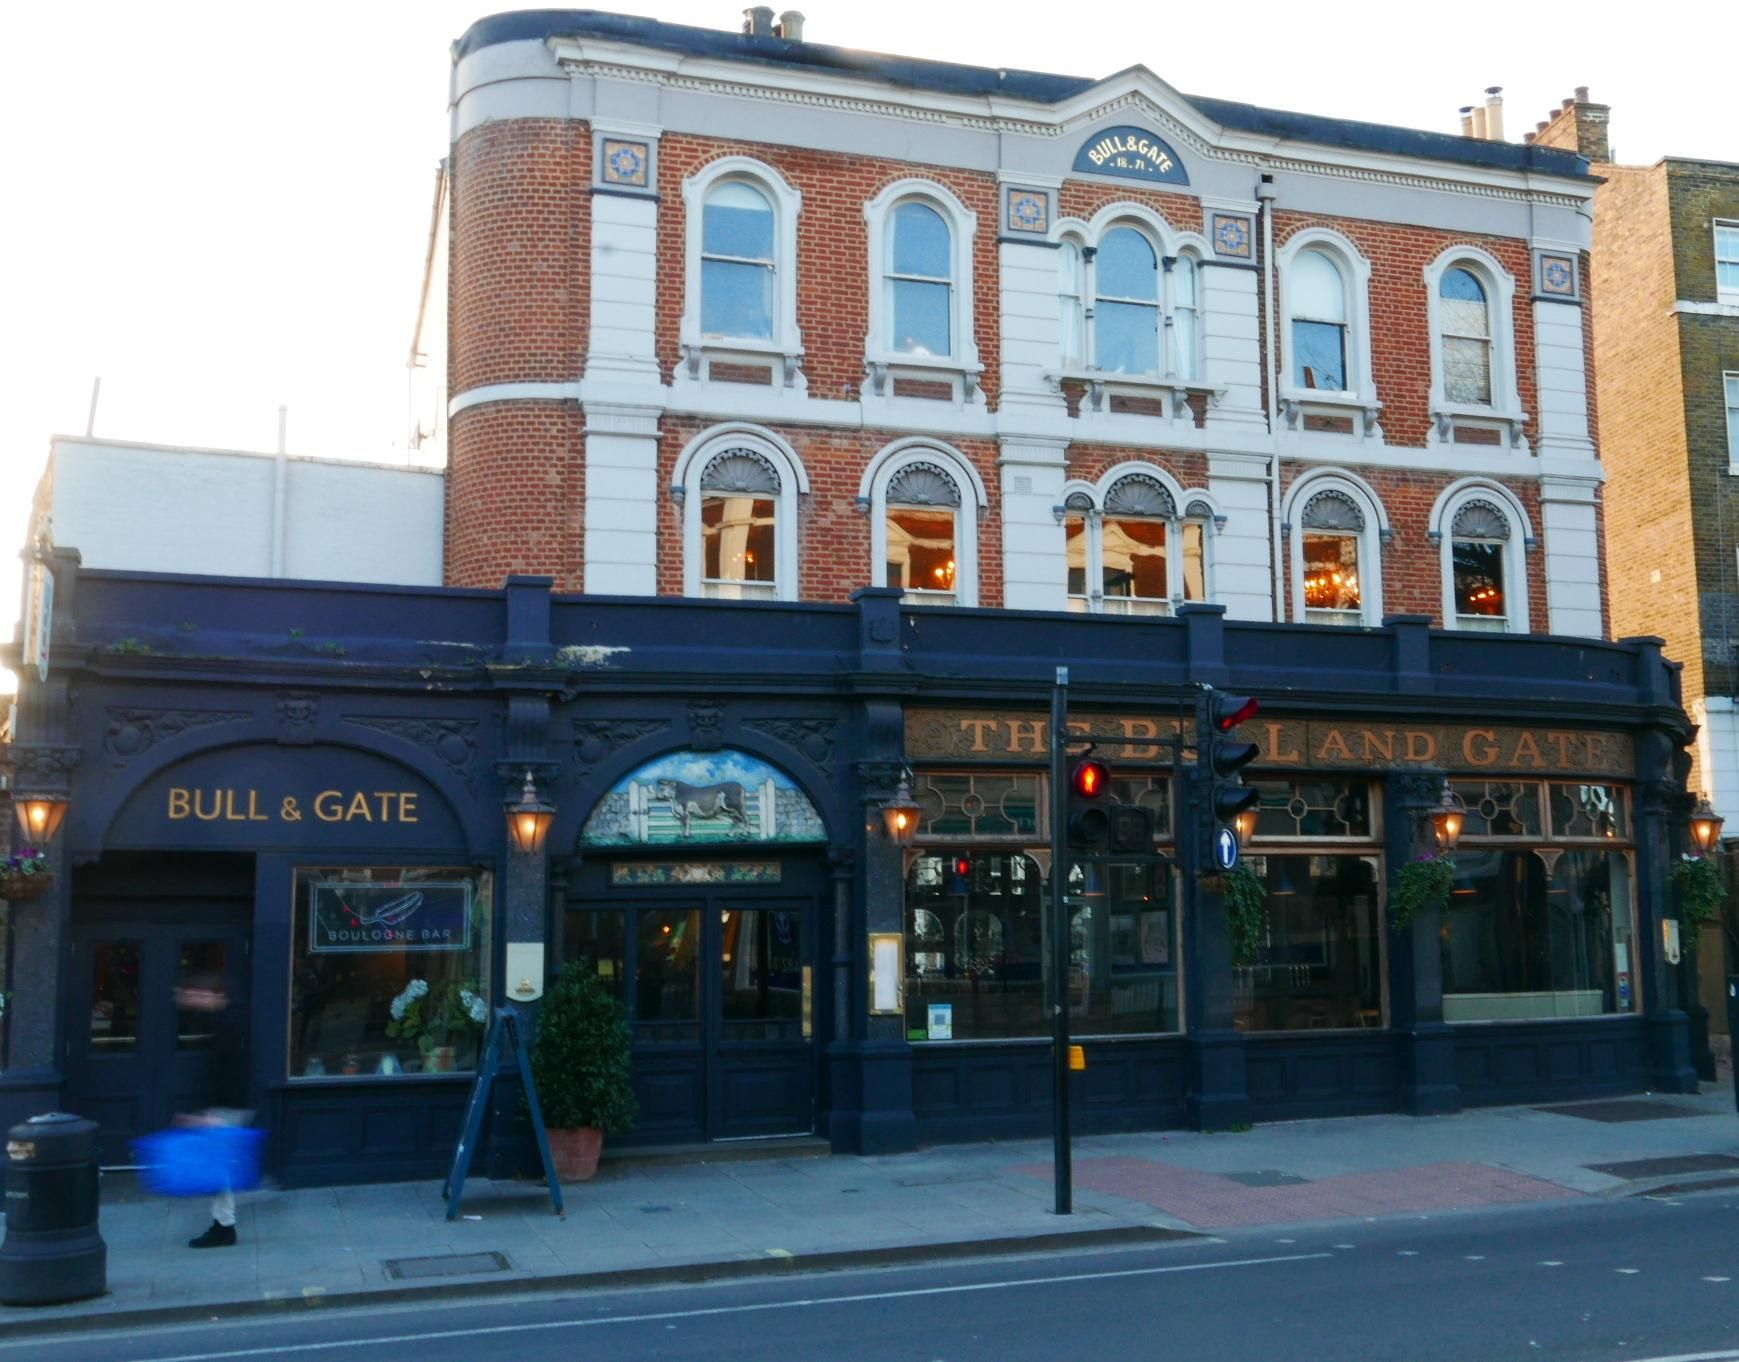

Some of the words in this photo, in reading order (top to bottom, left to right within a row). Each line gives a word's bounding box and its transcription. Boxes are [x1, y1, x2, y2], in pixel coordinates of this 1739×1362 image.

[1119, 719, 1299, 763] BL
[1316, 729, 1437, 762] AND
[1461, 728, 1610, 769] GATE
[167, 787, 269, 820] BULL
[280, 796, 302, 821] &
[313, 790, 419, 822] GATE
[328, 930, 415, 941] BOULOGNE
[421, 929, 452, 940] BAR
